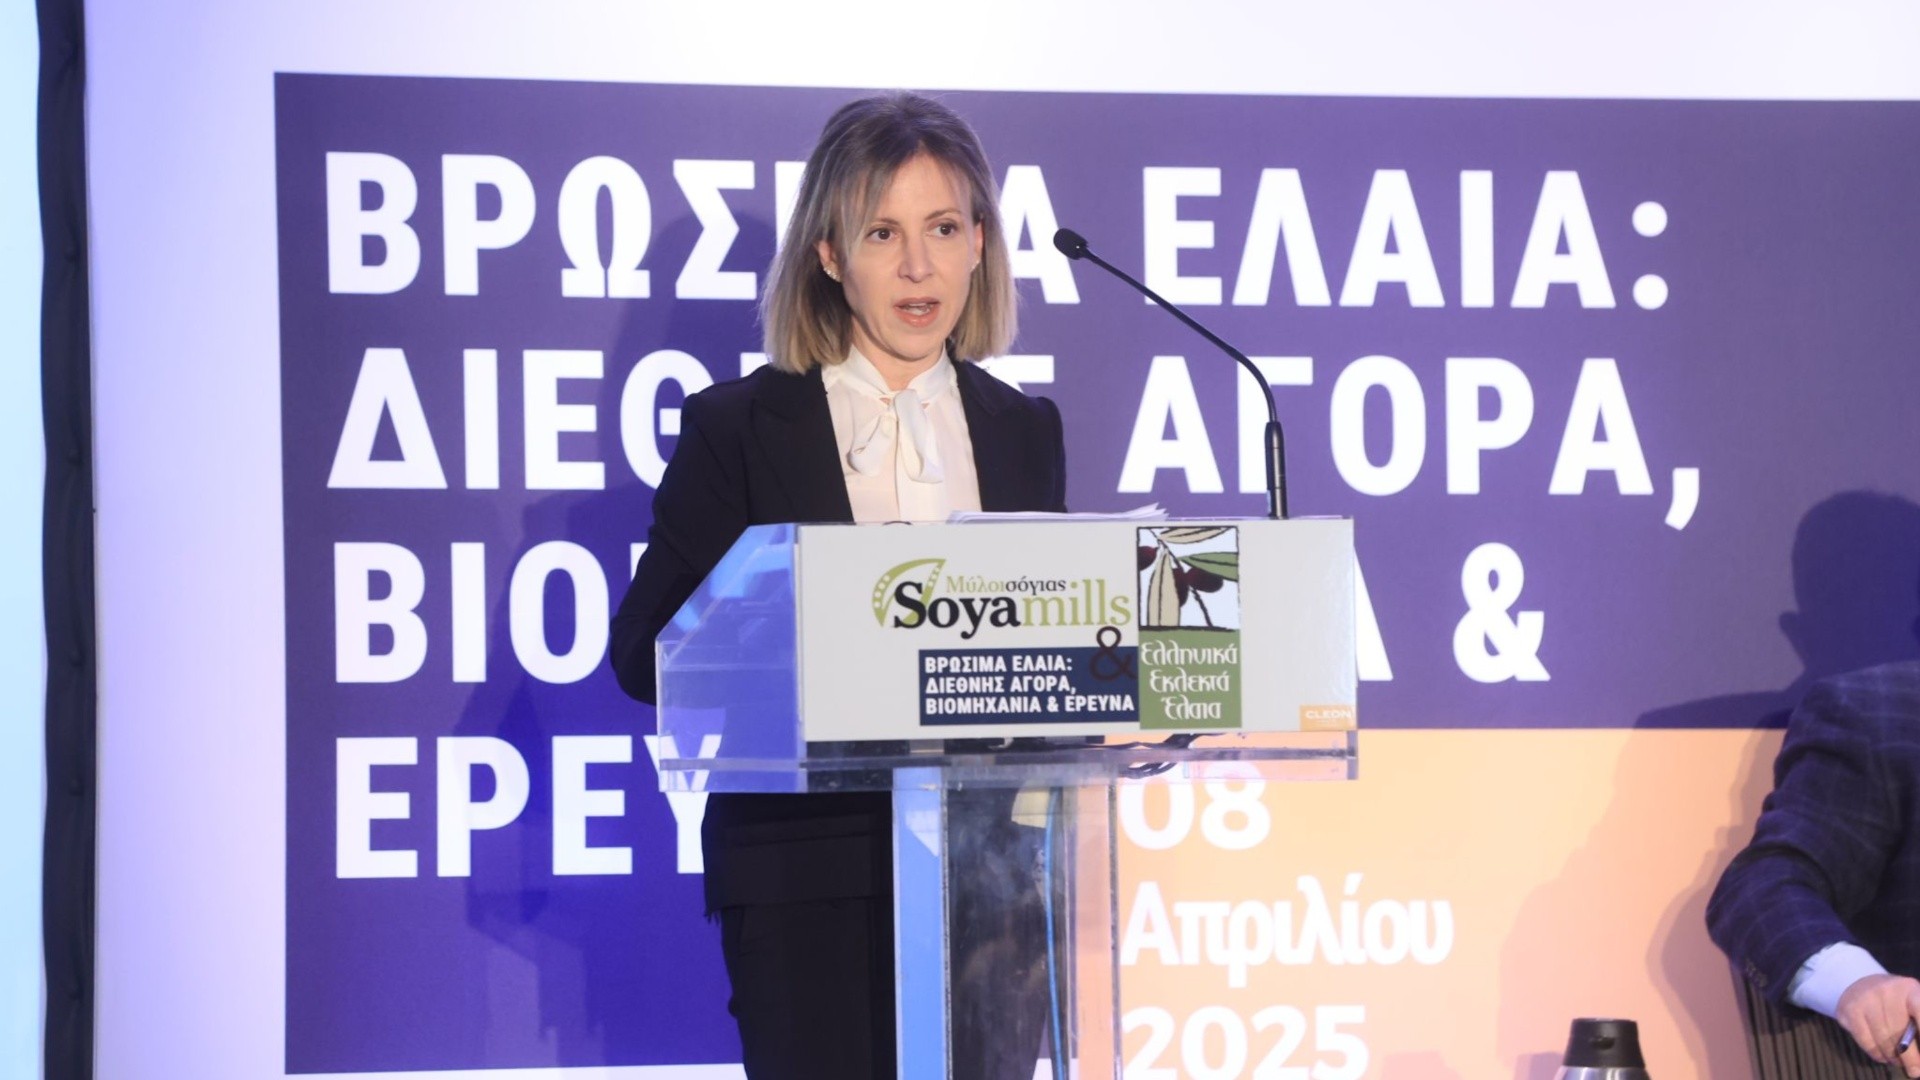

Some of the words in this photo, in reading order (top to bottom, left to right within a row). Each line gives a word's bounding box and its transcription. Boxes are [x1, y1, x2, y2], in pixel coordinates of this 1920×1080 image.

[325, 151, 1080, 304] ΒΡΩΣΑ
[1142, 167, 1668, 309] ΕΛΑΙΑ:
[1116, 355, 1700, 530] ΑΓΟΡΑ,
[893, 578, 1132, 639] Soyamills
[924, 655, 1007, 674] ΒΡΩΣΙΜΑ
[1012, 655, 1073, 672] ΕΛΑΙΑ:
[925, 676, 1004, 694] ΔΙΕΘΝΗΣ
[1010, 675, 1077, 695] ΑΓΟΡΑ,
[925, 697, 1041, 715] ΒΙΟΜΗΧΑΝΙΑ
[1046, 697, 1059, 712] &
[1065, 694, 1135, 712] ΕΡΕΥΝΑ
[1118, 760, 1271, 850] 08
[1119, 871, 1455, 988] Απριλίου
[1121, 1003, 1370, 1080] 2025
